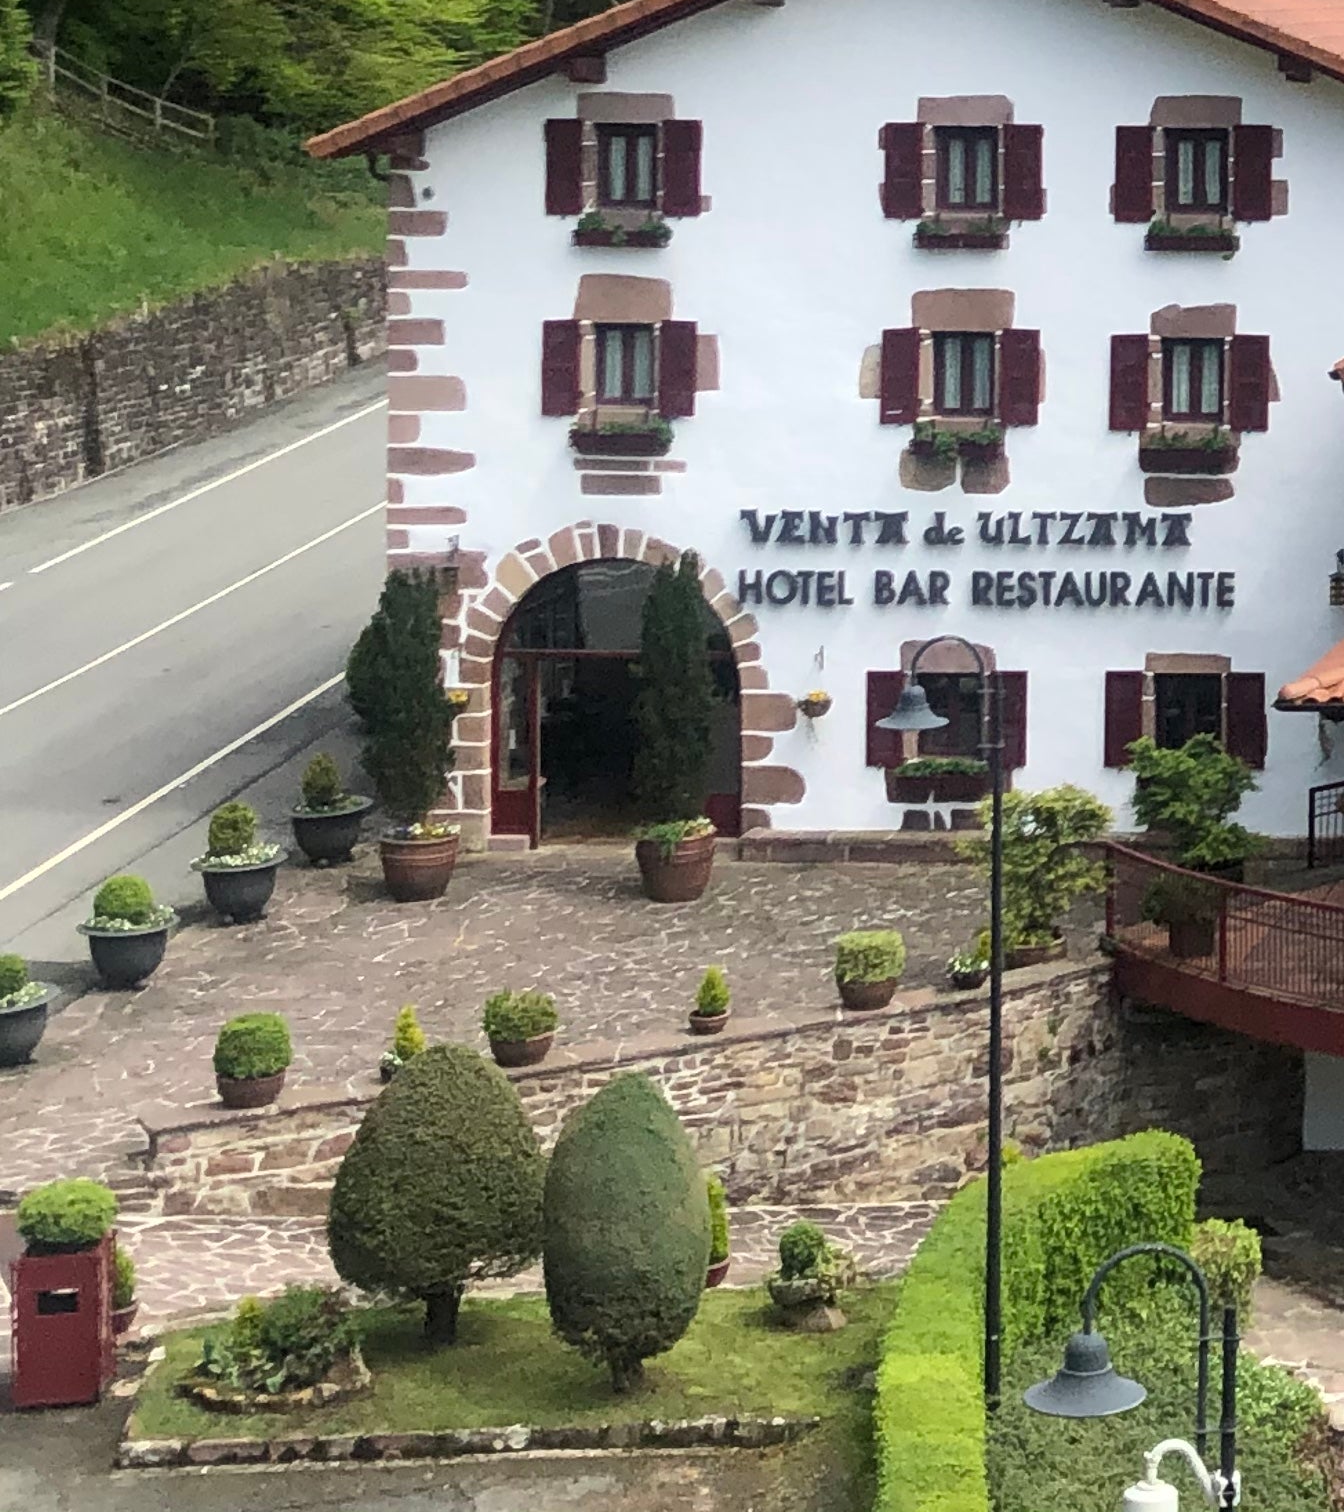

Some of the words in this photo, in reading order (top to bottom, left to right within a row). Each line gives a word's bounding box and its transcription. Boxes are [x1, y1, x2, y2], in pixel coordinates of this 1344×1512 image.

[739, 509, 909, 546] VENTA
[924, 512, 965, 546] de
[977, 511, 1193, 547] ULTZAMA
[739, 570, 853, 606] HOTEL
[874, 570, 949, 606] BAR
[972, 571, 1235, 608] RESTAURANTE
